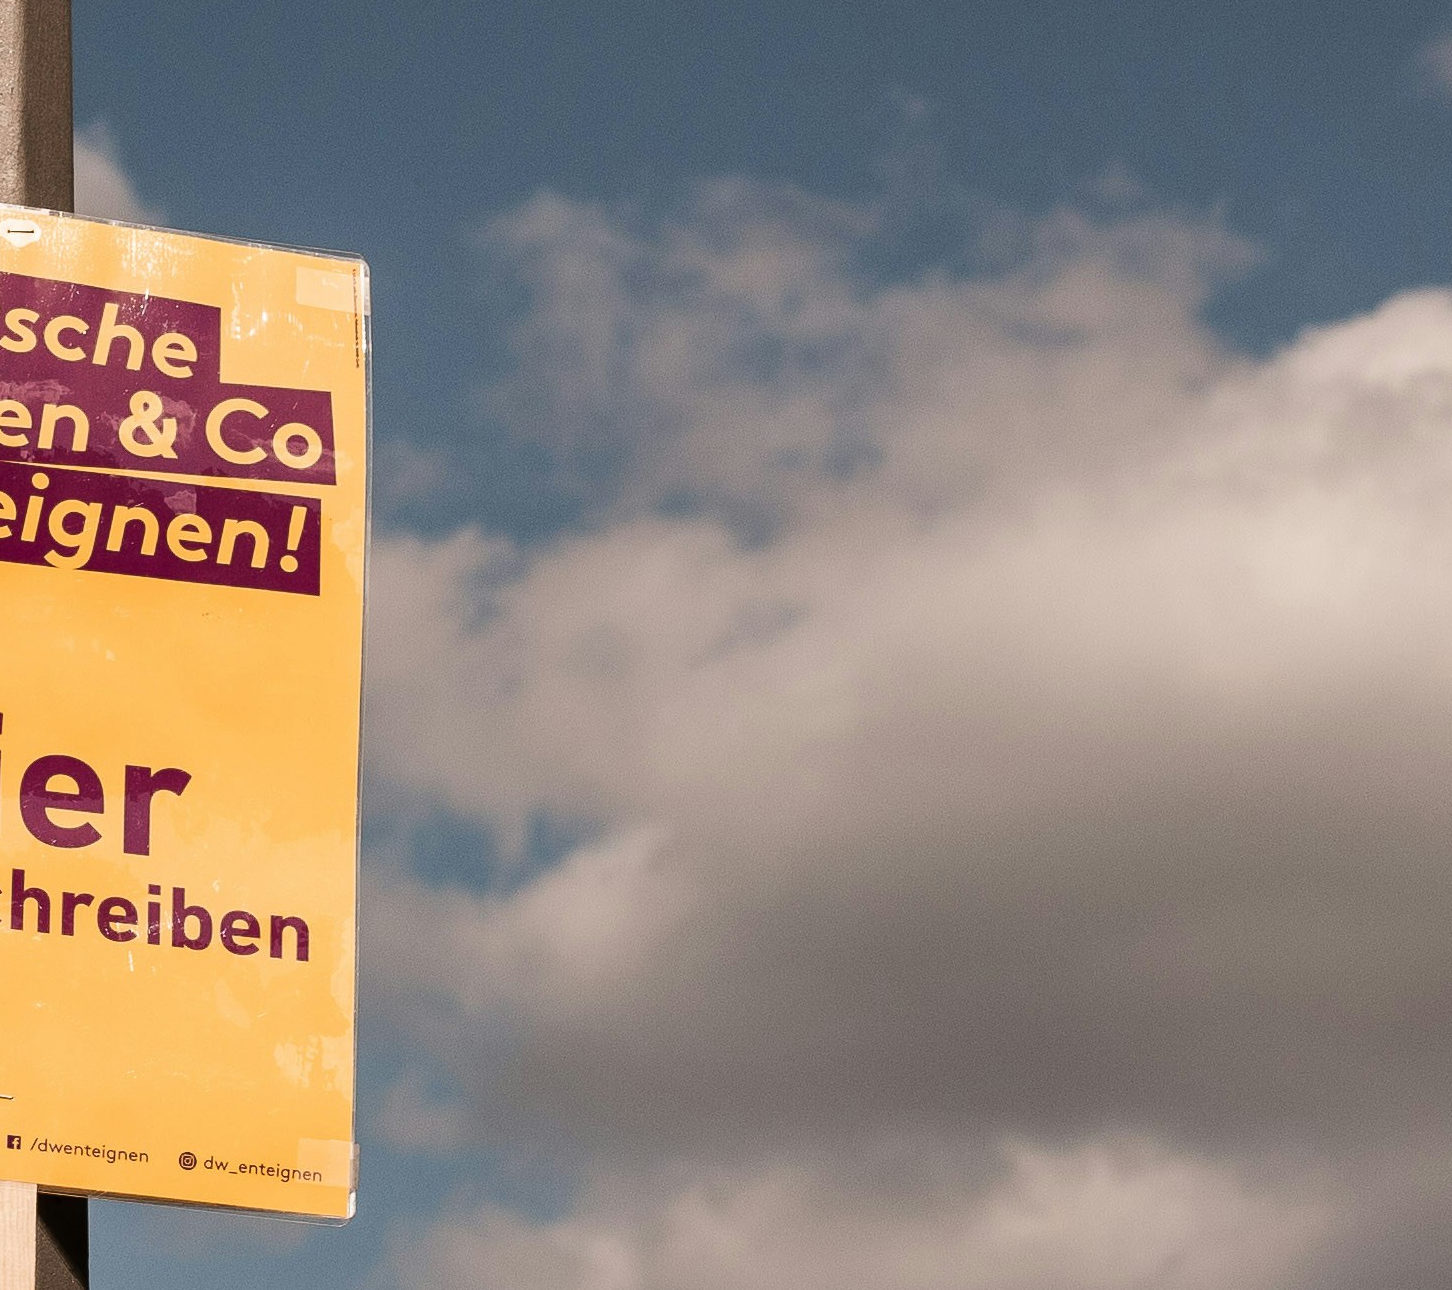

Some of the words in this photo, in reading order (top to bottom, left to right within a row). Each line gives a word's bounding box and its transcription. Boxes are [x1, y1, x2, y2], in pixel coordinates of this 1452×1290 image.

[118, 391, 177, 459] &
[206, 398, 324, 470] Co
[30, 1137, 149, 1163] /dwenteignen
[203, 1156, 323, 1183] dw_enteignen
